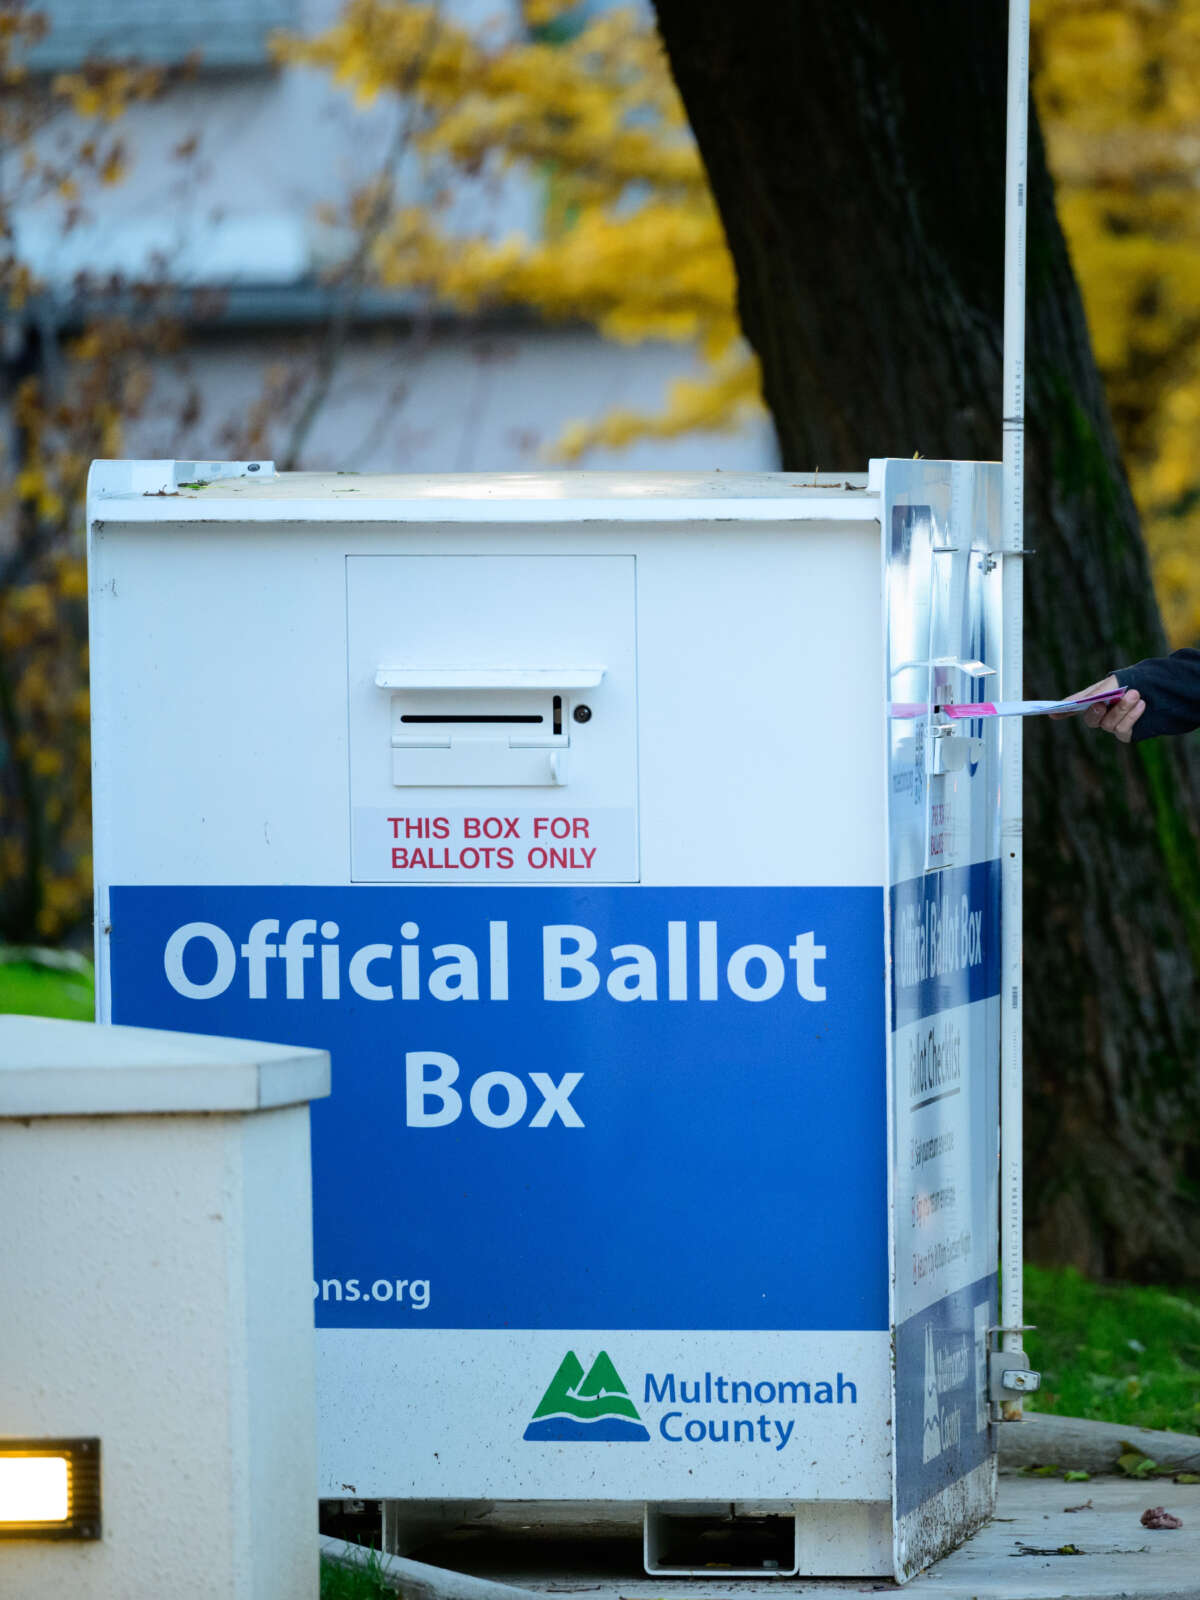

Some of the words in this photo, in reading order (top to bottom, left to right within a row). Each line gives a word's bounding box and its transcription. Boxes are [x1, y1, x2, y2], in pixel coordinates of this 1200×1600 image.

[387, 817, 450, 839] THIS
[463, 817, 519, 839] BOX
[534, 817, 589, 839] FOR
[391, 847, 514, 869] BALLOTS
[527, 847, 597, 869] ONLY
[930, 895, 960, 978] Ballot
[961, 893, 982, 969] Box
[164, 918, 509, 1001] Official
[542, 920, 827, 1002] Ballot
[405, 1051, 585, 1129] Box
[643, 1371, 857, 1404] Multnomah
[659, 1411, 795, 1452] County
